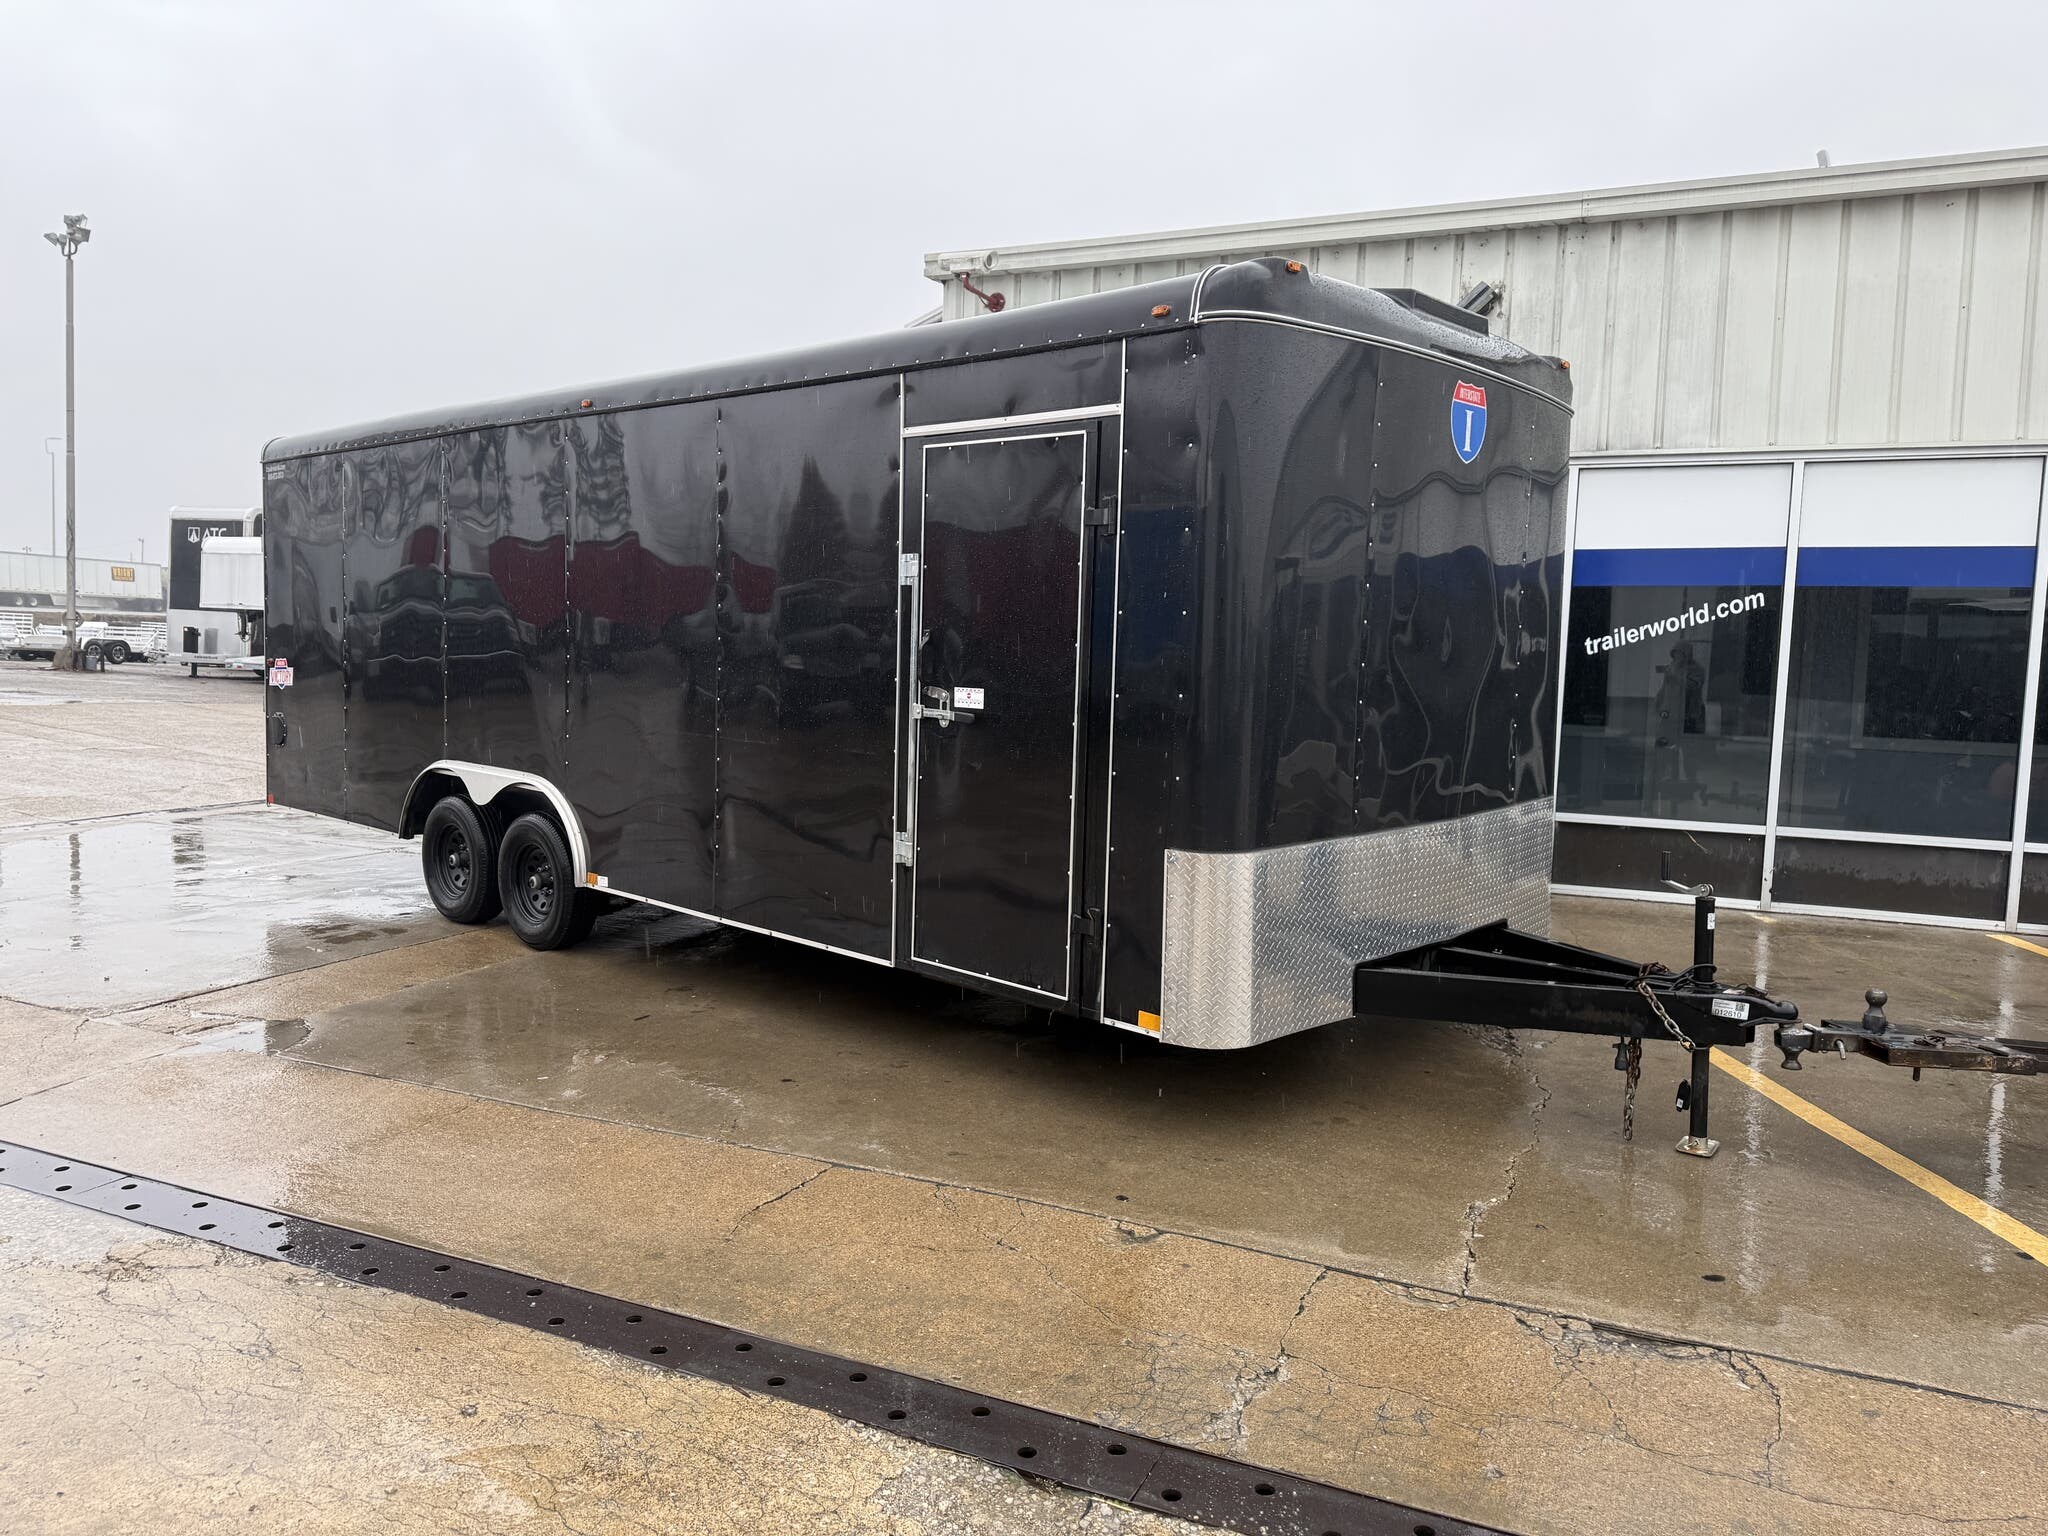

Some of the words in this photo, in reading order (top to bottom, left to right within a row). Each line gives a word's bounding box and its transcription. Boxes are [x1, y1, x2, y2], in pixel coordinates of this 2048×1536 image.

[1460, 387, 1482, 403] INTERSTATE
[1462, 409, 1474, 452] I
[1584, 592, 1765, 655] trailerworld.com
[270, 670, 292, 684] VICTORY
